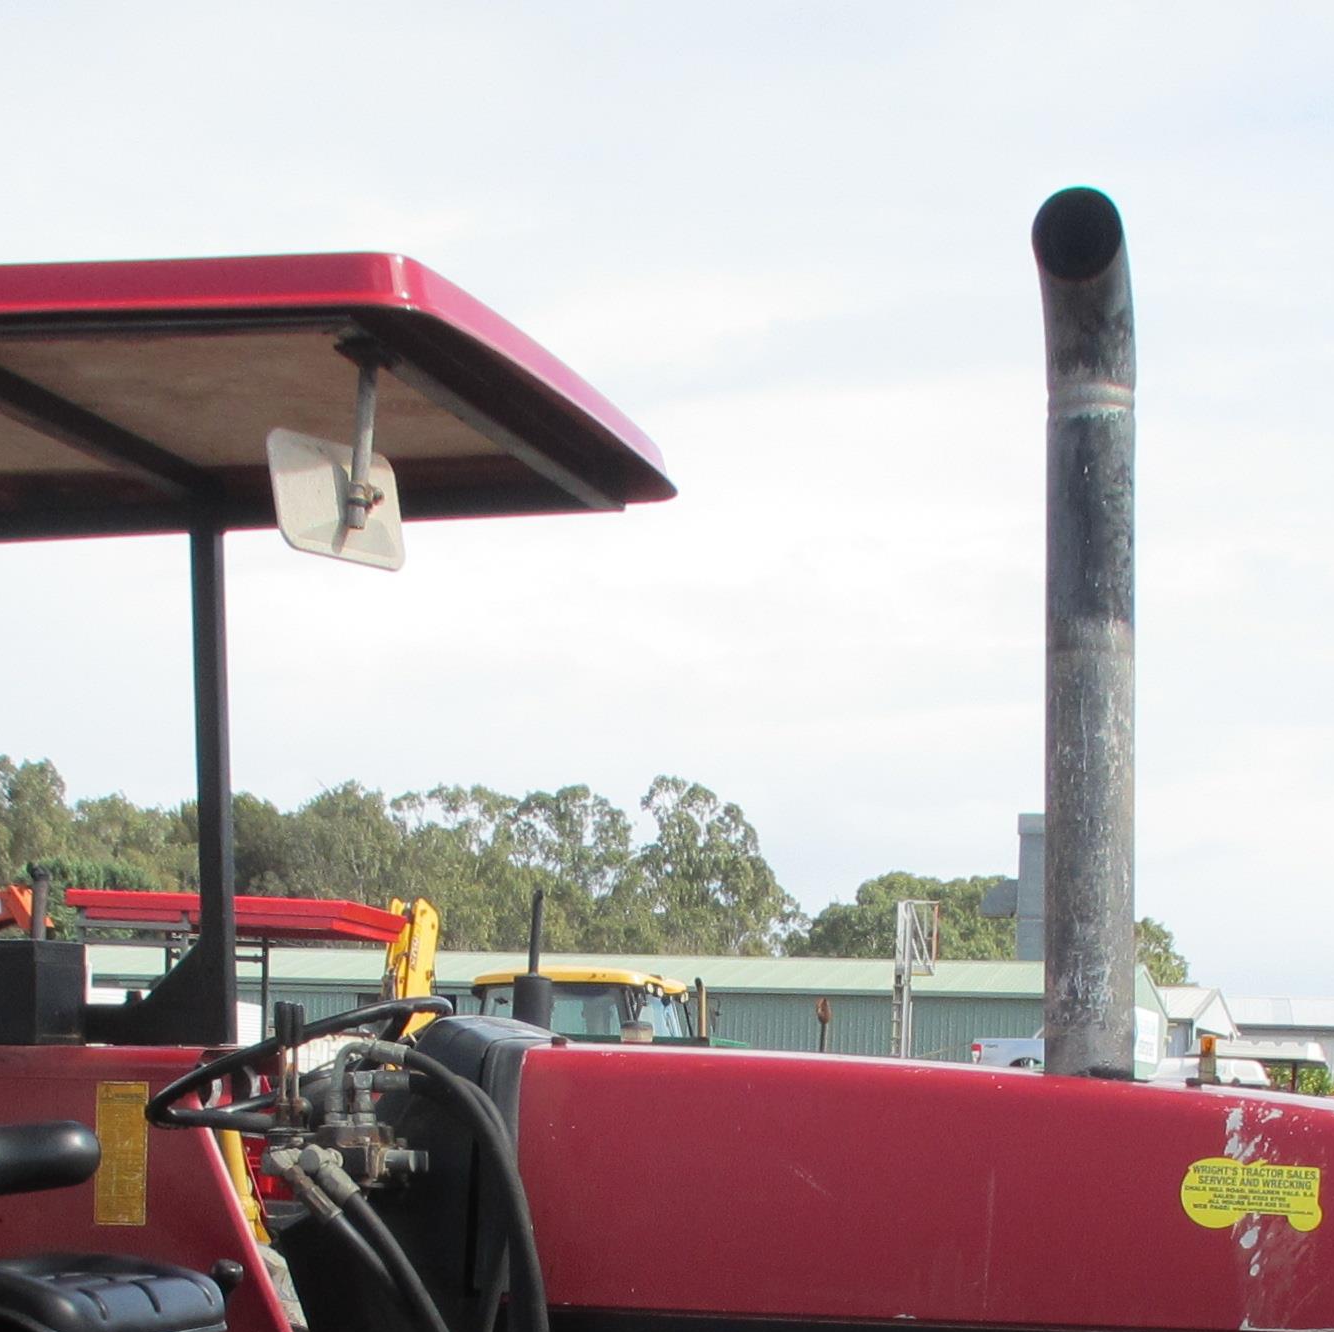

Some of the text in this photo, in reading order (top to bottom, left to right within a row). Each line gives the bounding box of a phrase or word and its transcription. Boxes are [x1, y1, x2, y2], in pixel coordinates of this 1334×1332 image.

[1193, 1165, 1316, 1180] WRIGHT'S TRACTOR SALES
[1198, 1175, 1312, 1190] SERVICE AND WRECKING
